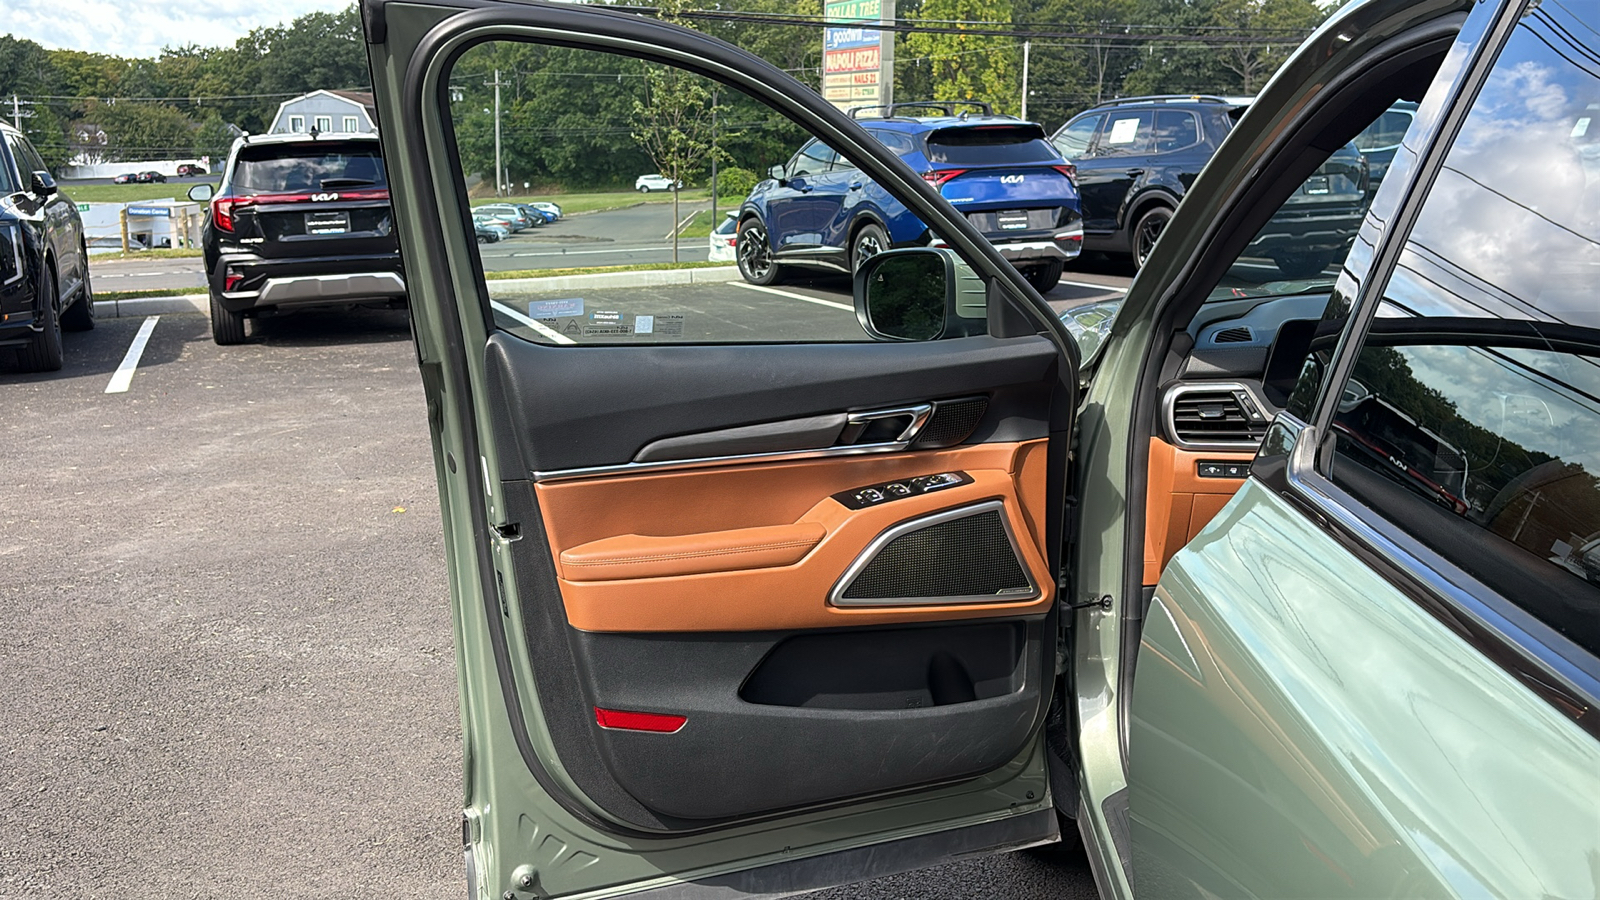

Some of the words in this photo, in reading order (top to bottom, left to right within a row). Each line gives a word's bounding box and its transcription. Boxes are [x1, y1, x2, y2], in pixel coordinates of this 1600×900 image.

[827, 4, 857, 21] DOLLAR
[859, 0, 880, 17] TREE
[833, 28, 863, 48] goodwill
[826, 52, 855, 71] NAPOLI
[855, 49, 879, 69] PIZZA
[854, 74, 869, 84] NAILS
[1001, 175, 1025, 184] KIA
[311, 193, 338, 201] KIA
